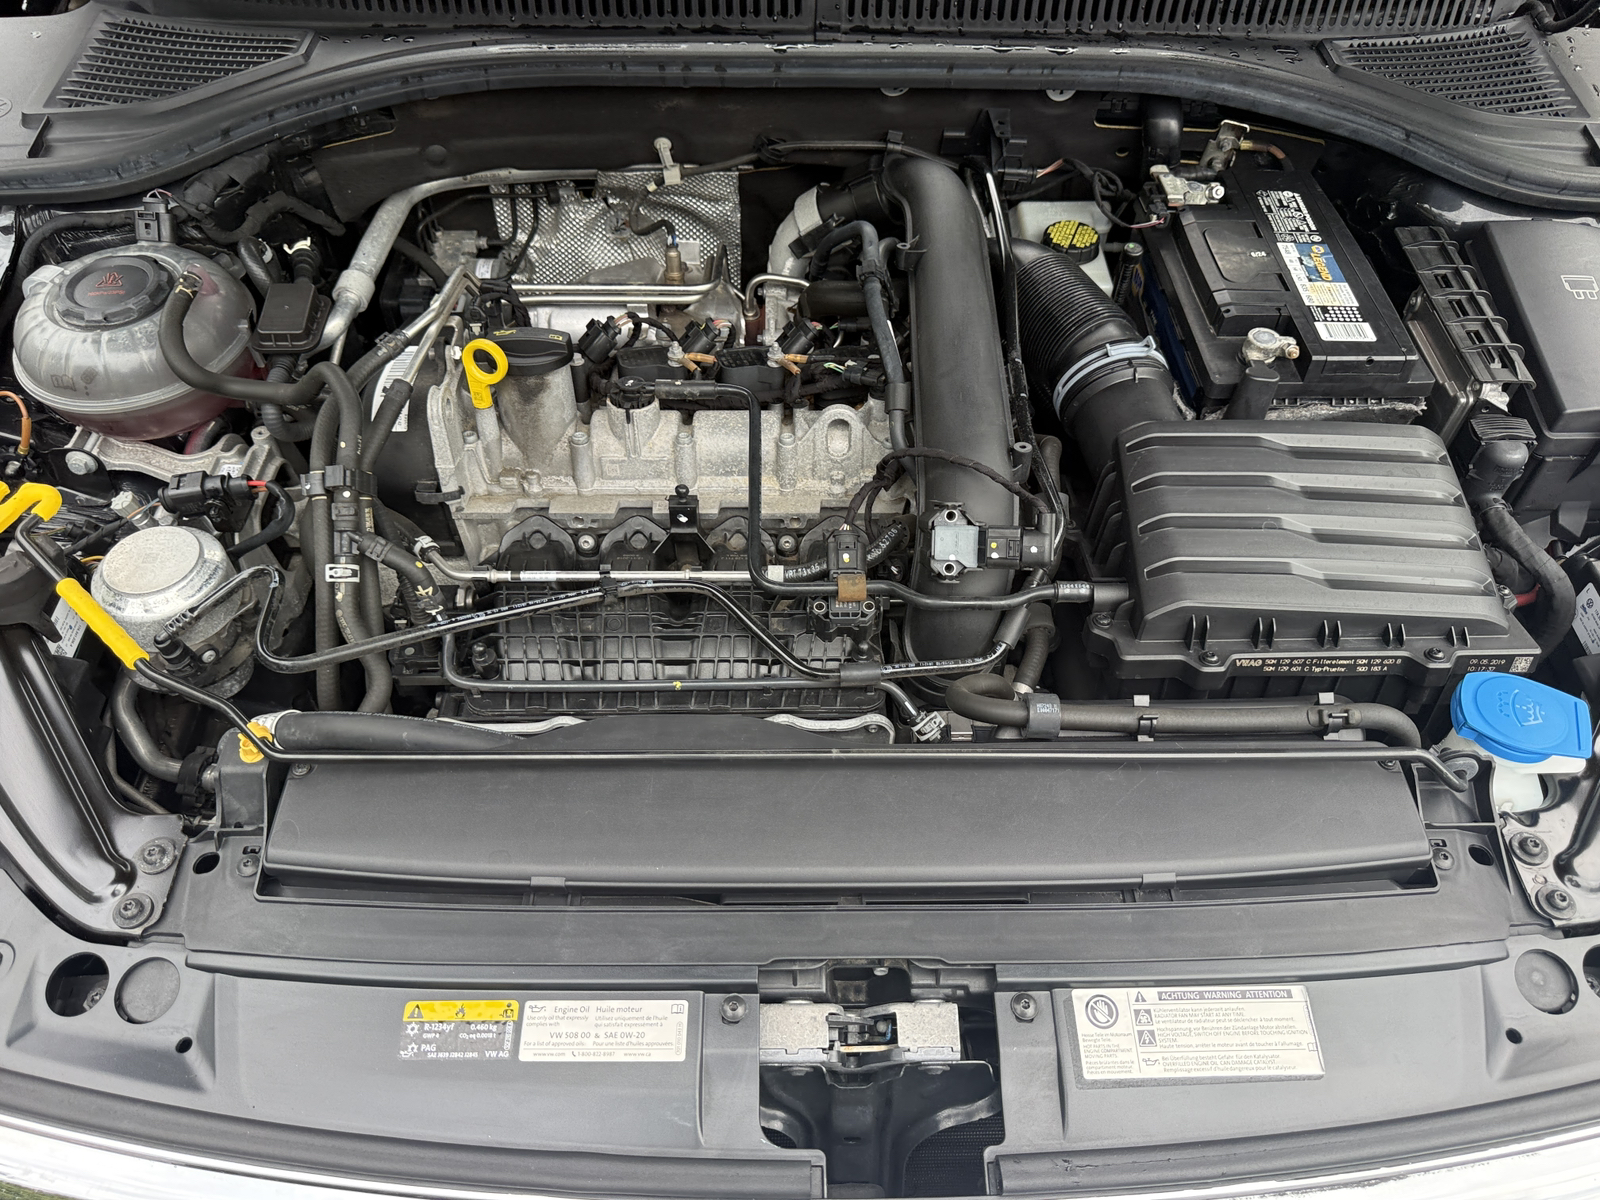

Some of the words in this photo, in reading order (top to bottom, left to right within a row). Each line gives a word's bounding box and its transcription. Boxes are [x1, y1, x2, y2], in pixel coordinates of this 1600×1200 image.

[1310, 253, 1332, 281] LEGEND
[554, 1006, 578, 1015] Engine
[424, 1023, 455, 1032] R-1234yf
